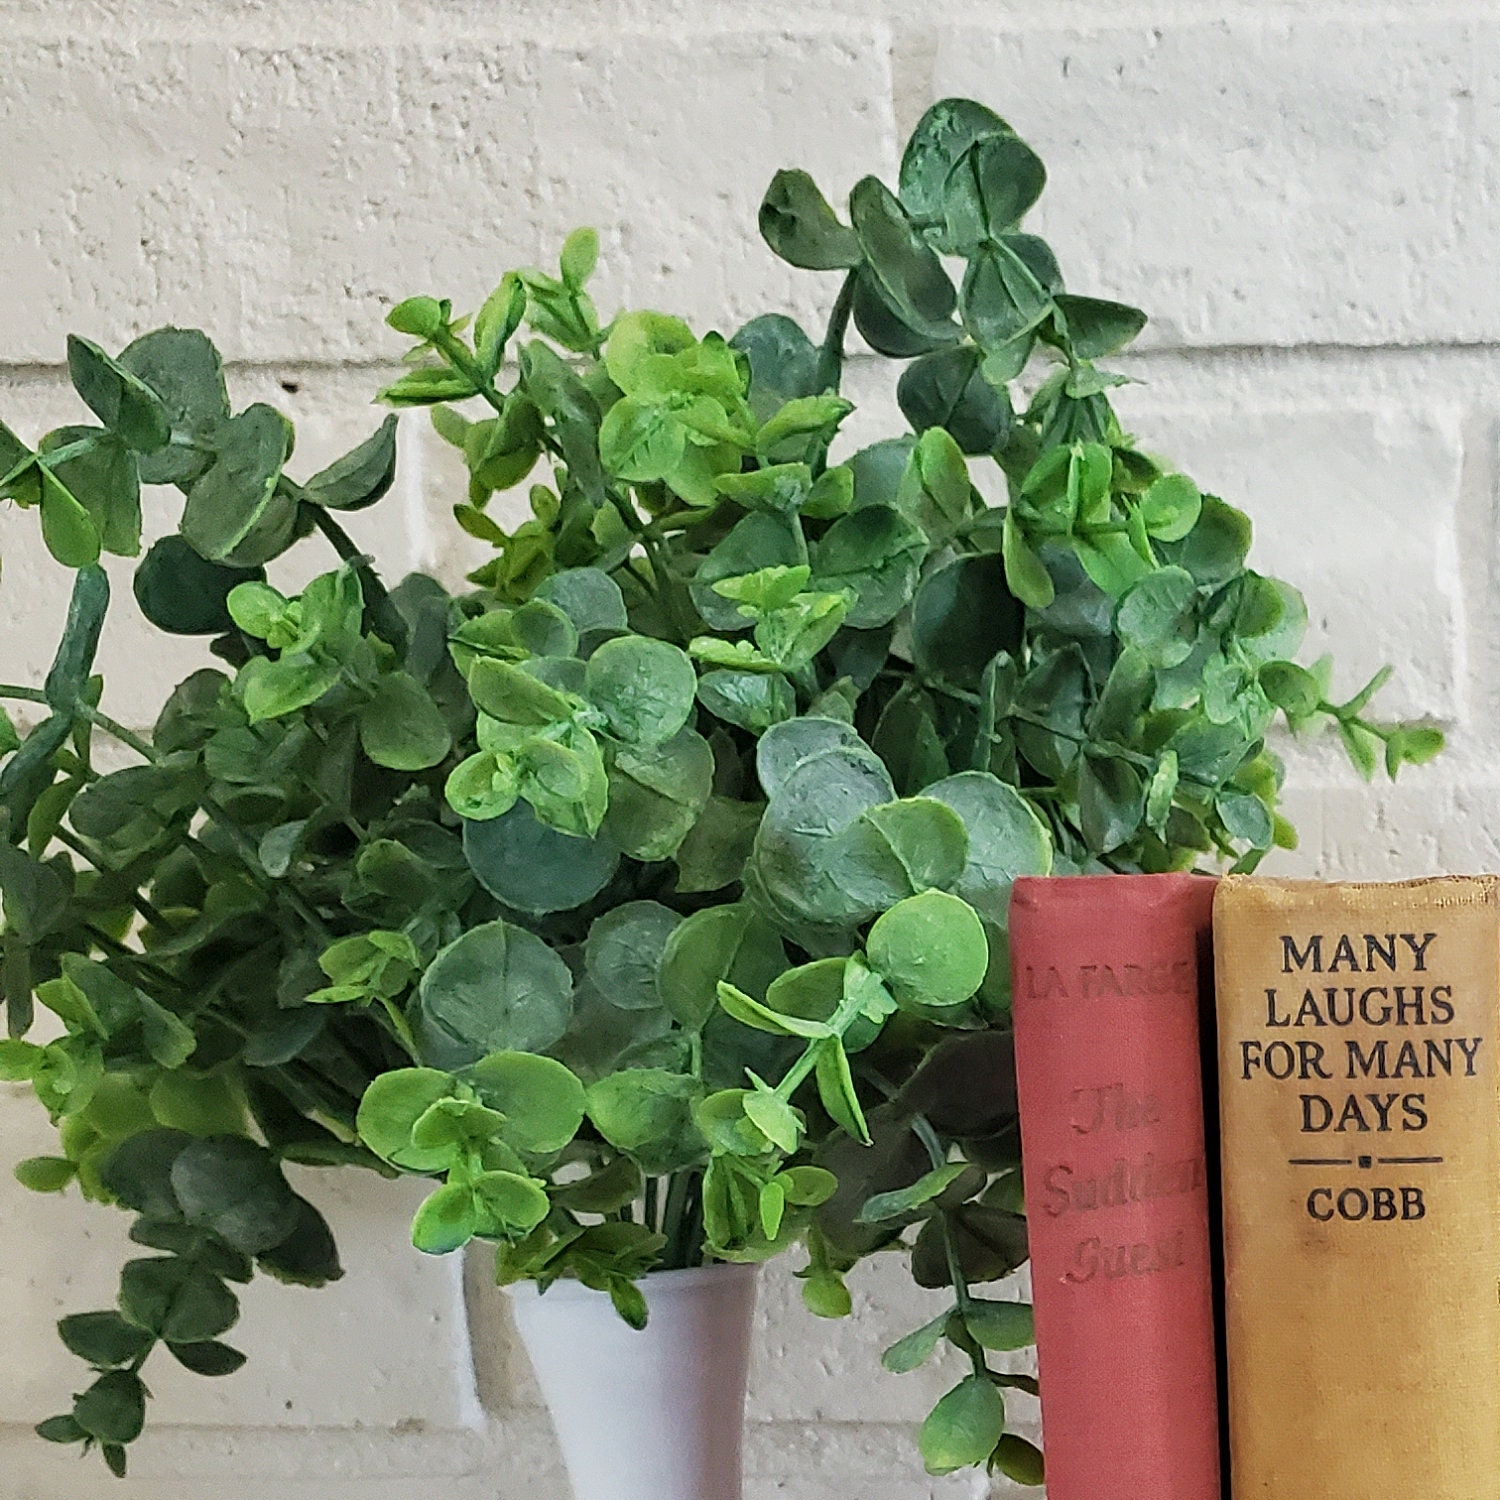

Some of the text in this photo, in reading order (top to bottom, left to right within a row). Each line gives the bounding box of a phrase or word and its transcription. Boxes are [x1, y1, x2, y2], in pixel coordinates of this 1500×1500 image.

[1279, 933, 1437, 973] MANY
[1026, 965, 1069, 999] LA
[1264, 985, 1456, 1027] LAUGHS
[1239, 1037, 1483, 1080] FOR MANY
[1070, 1082, 1162, 1135] The
[1299, 1093, 1428, 1132] DAYS
[1307, 1187, 1426, 1221] COBB
